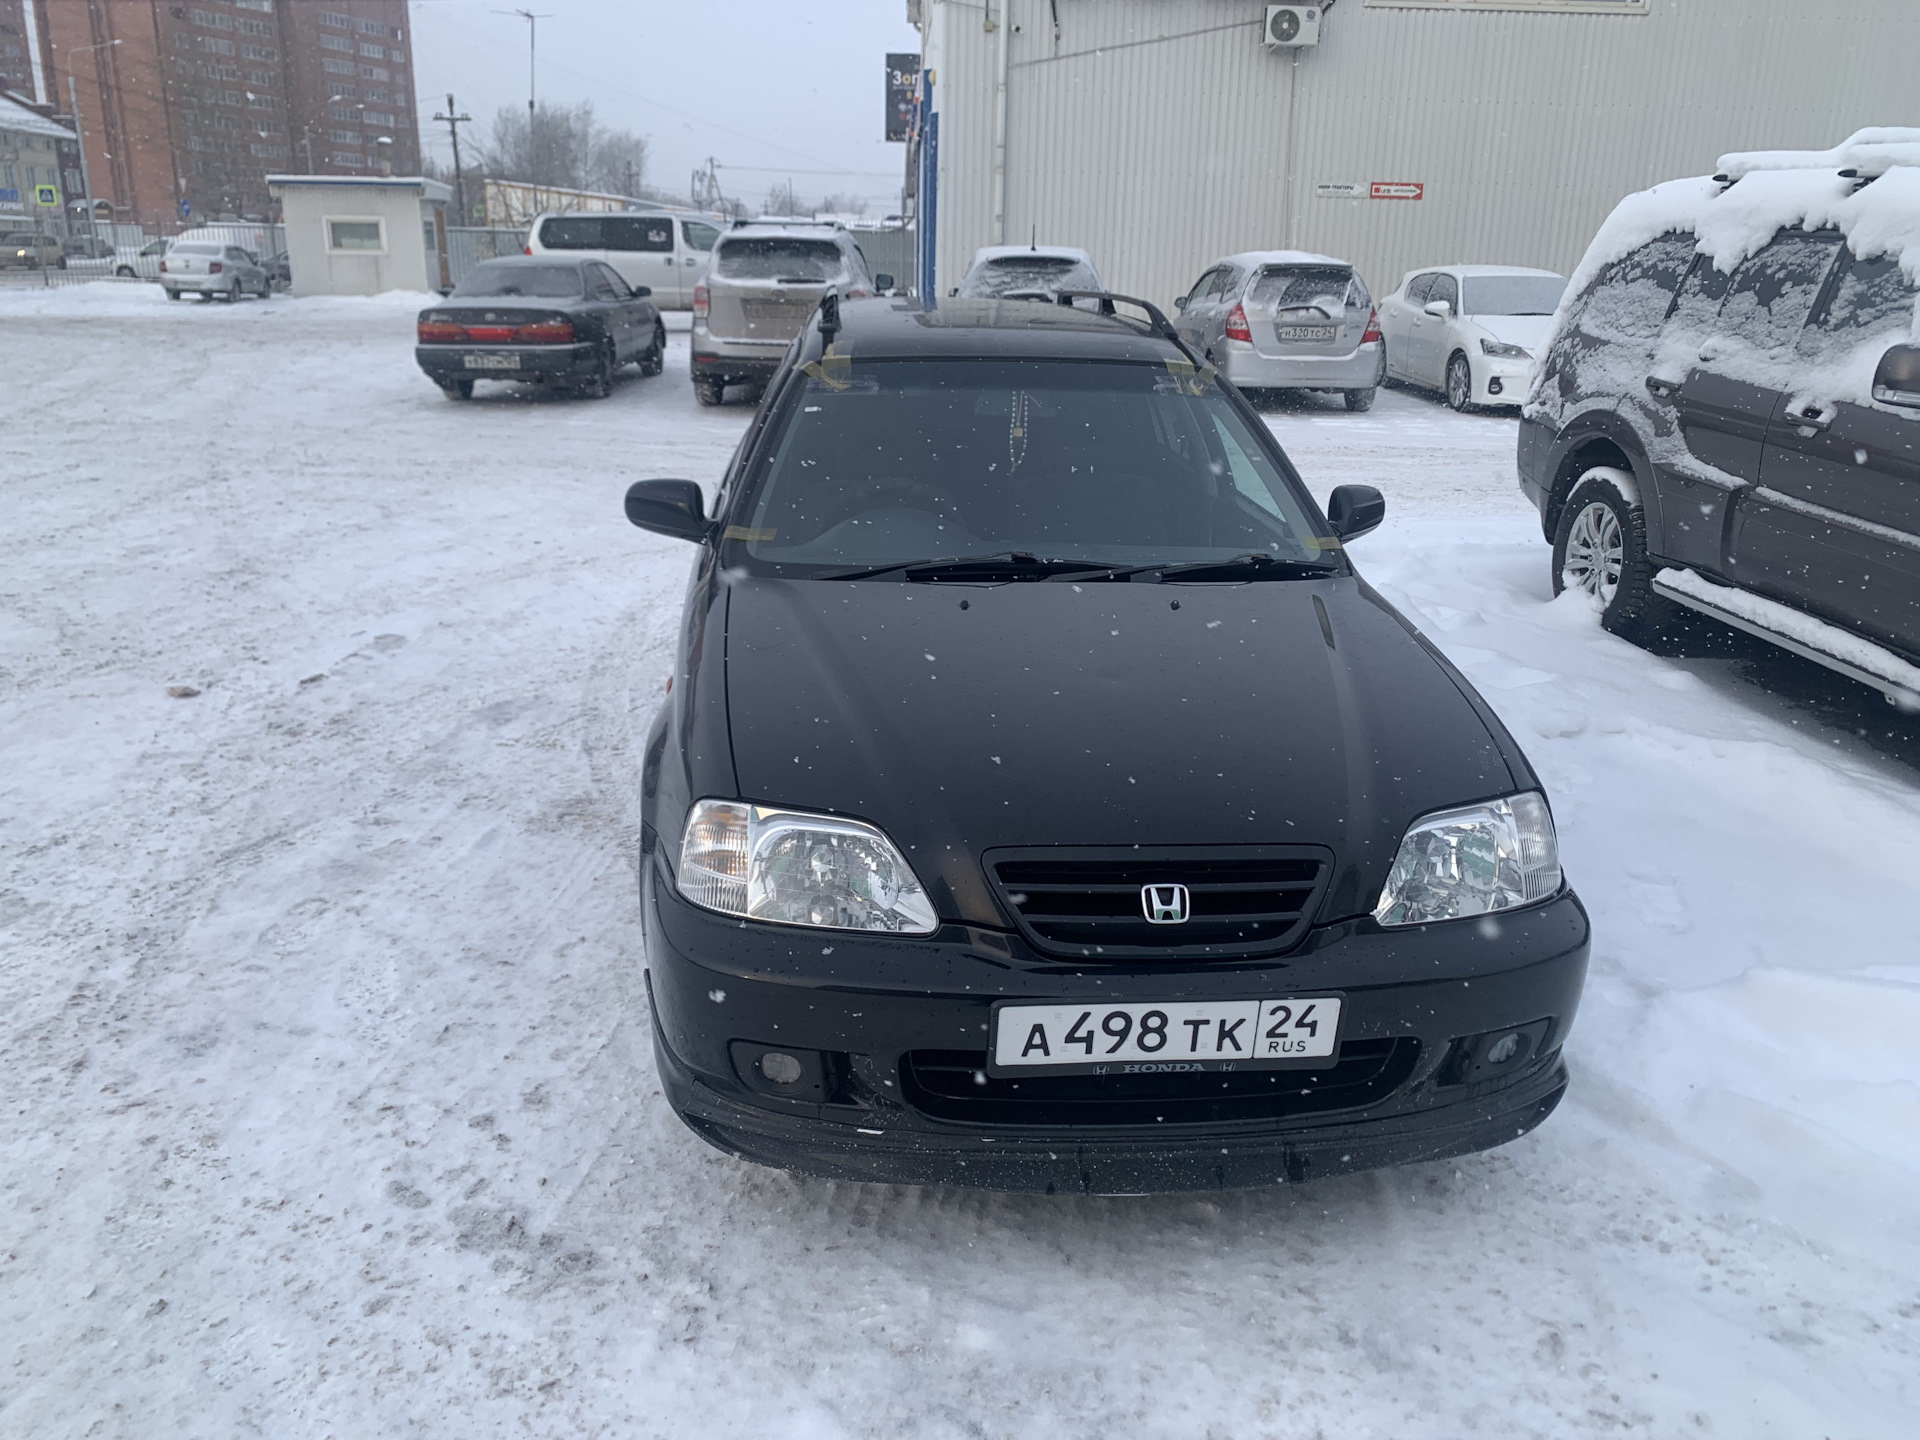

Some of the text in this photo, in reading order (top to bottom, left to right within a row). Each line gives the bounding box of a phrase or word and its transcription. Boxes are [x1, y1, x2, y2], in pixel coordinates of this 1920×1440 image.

[1266, 1004, 1318, 1039] 24
[1268, 1040, 1306, 1053] RUS
[1122, 1062, 1206, 1074] HONDA
